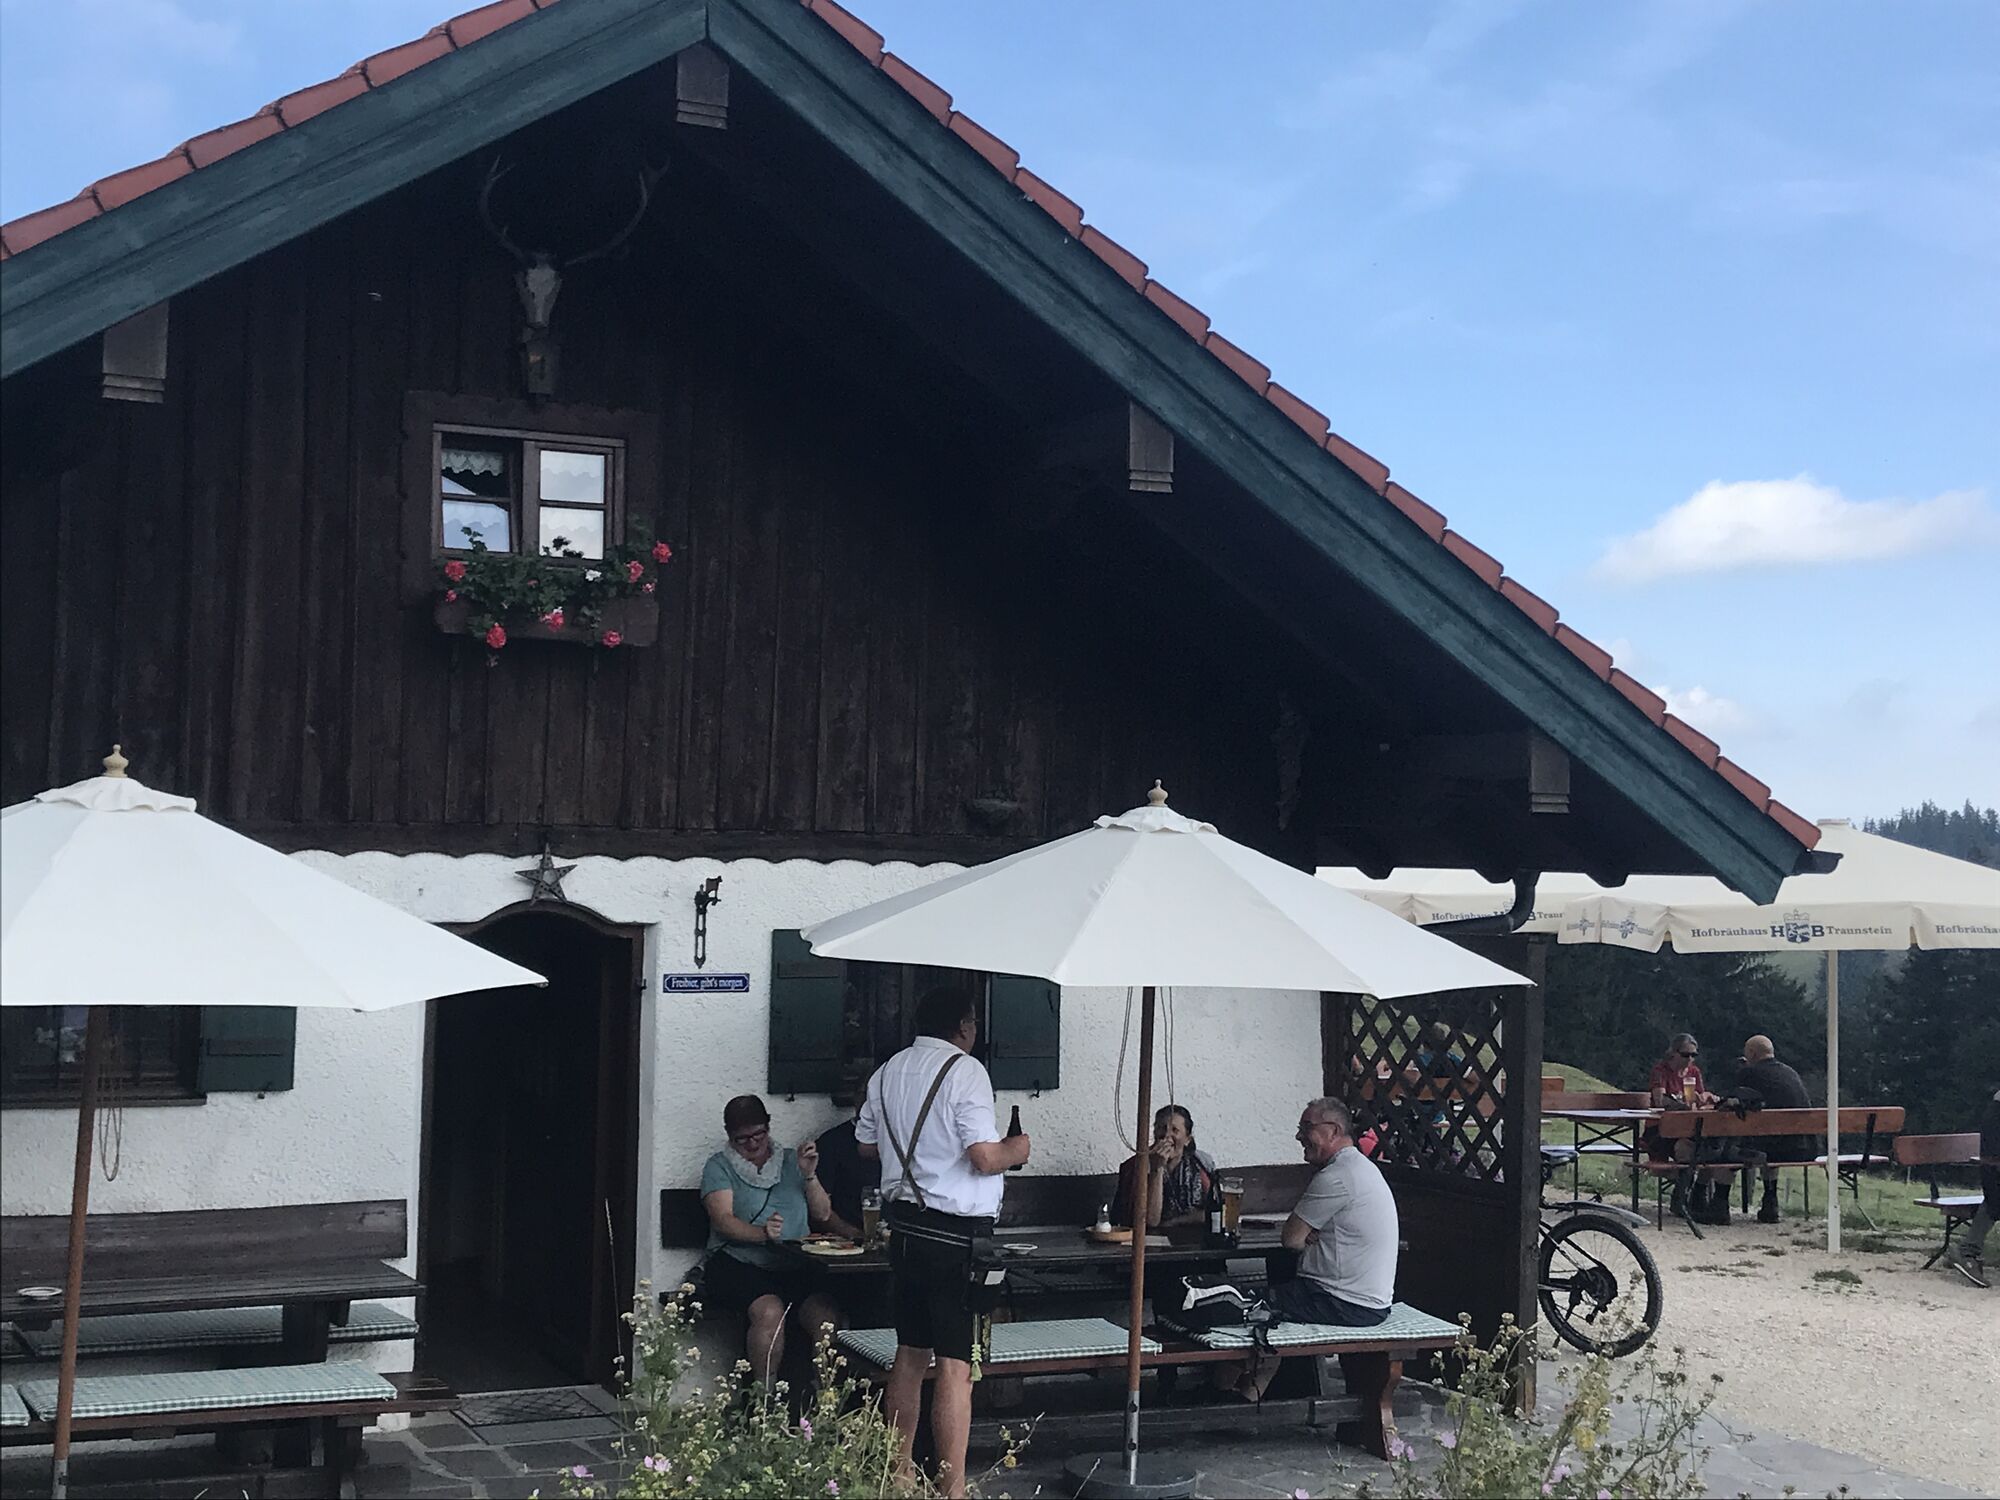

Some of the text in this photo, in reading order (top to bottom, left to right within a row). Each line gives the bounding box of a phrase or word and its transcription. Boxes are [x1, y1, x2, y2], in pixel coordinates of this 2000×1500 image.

[1432, 911, 1490, 921] Hofbräuha
[1690, 926, 1769, 938] Hofbräuhaus
[1826, 925, 1893, 935] Traunstein
[1935, 924, 2000, 934] Hofbräuha
